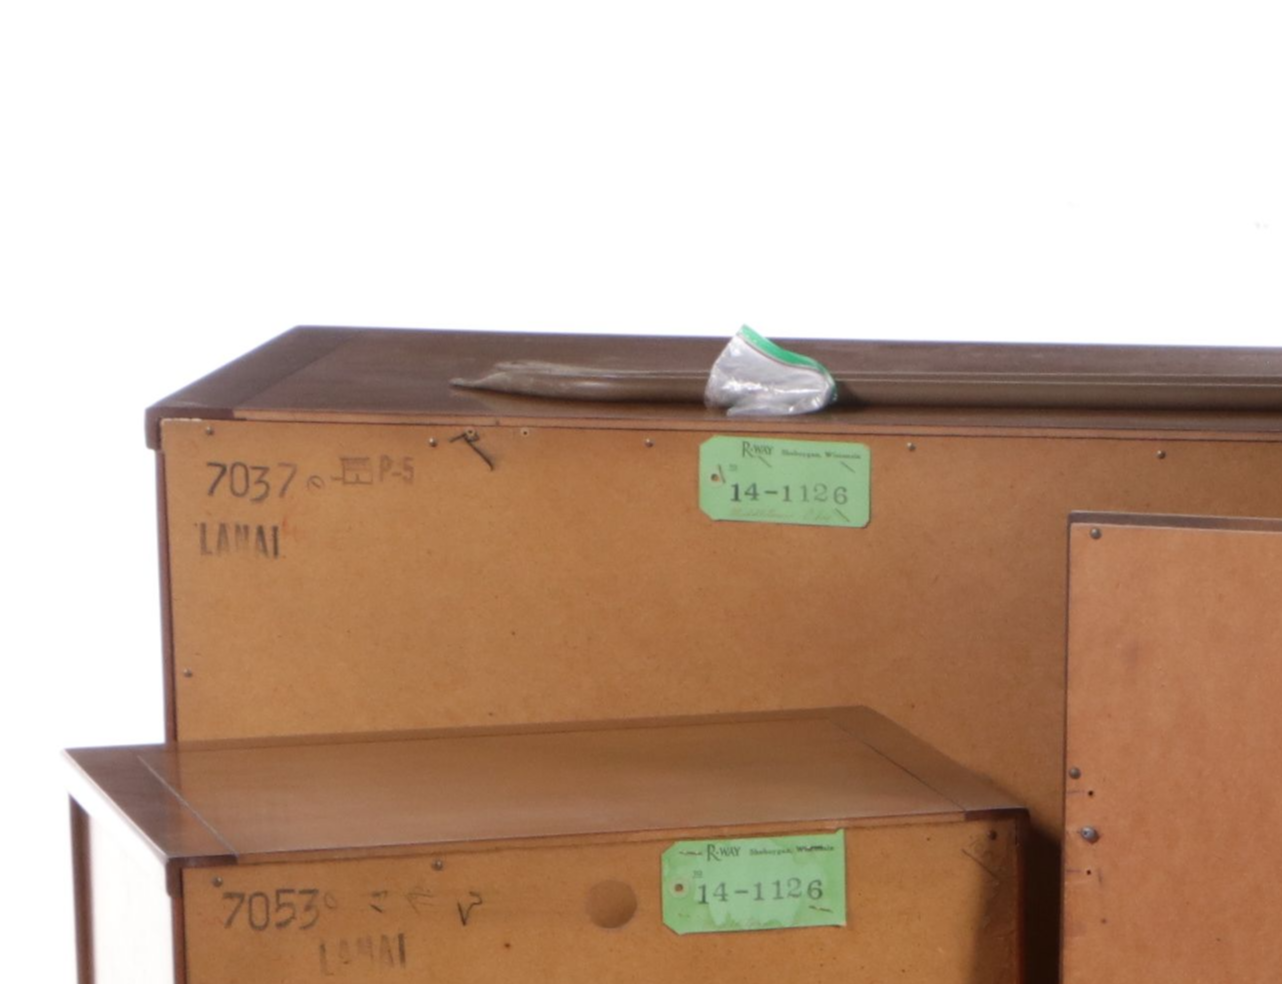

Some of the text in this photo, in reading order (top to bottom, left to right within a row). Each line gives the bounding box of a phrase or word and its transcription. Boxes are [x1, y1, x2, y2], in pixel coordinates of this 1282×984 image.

[206, 461, 297, 502] 7037
[730, 482, 848, 505] 14-1126
[697, 877, 824, 905] 14-1126
